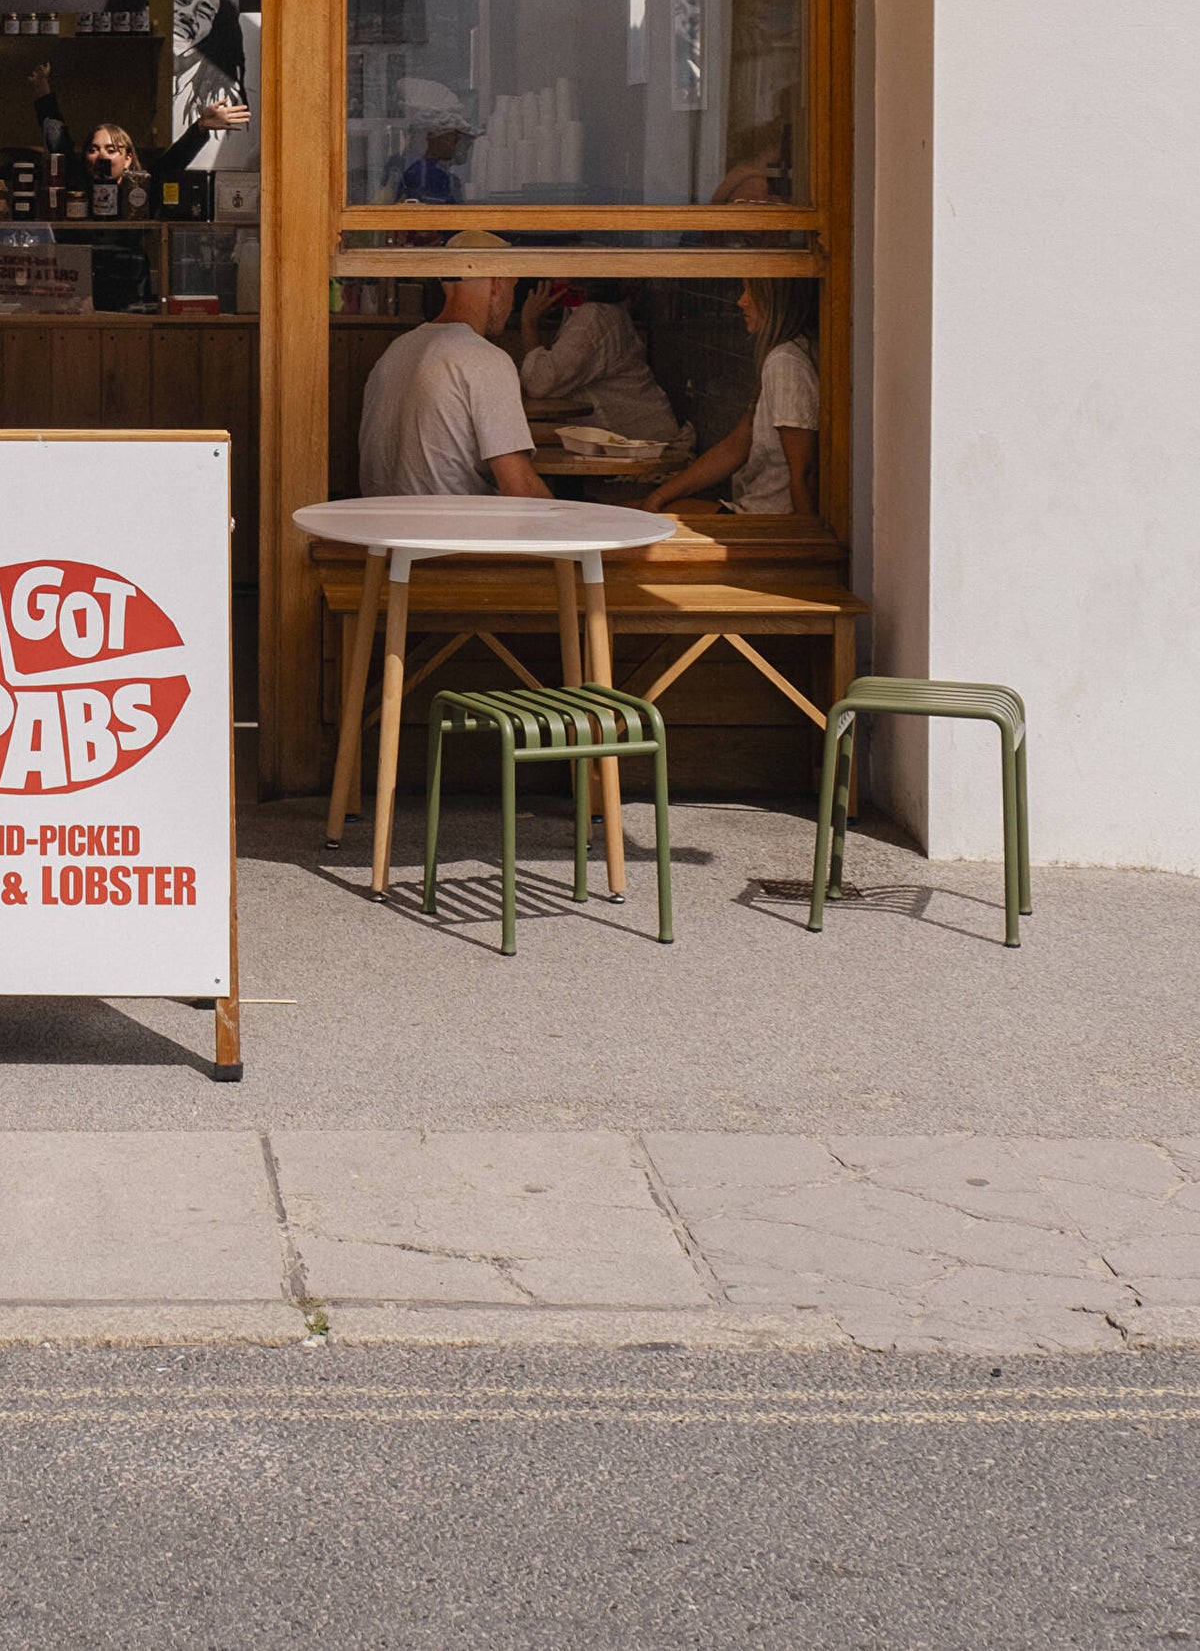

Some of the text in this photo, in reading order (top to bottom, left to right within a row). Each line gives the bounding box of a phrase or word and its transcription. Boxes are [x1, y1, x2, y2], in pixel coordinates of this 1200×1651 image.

[10, 565, 138, 659] GOT
[0, 870, 29, 906] &
[40, 864, 198, 906] LOBSTER
